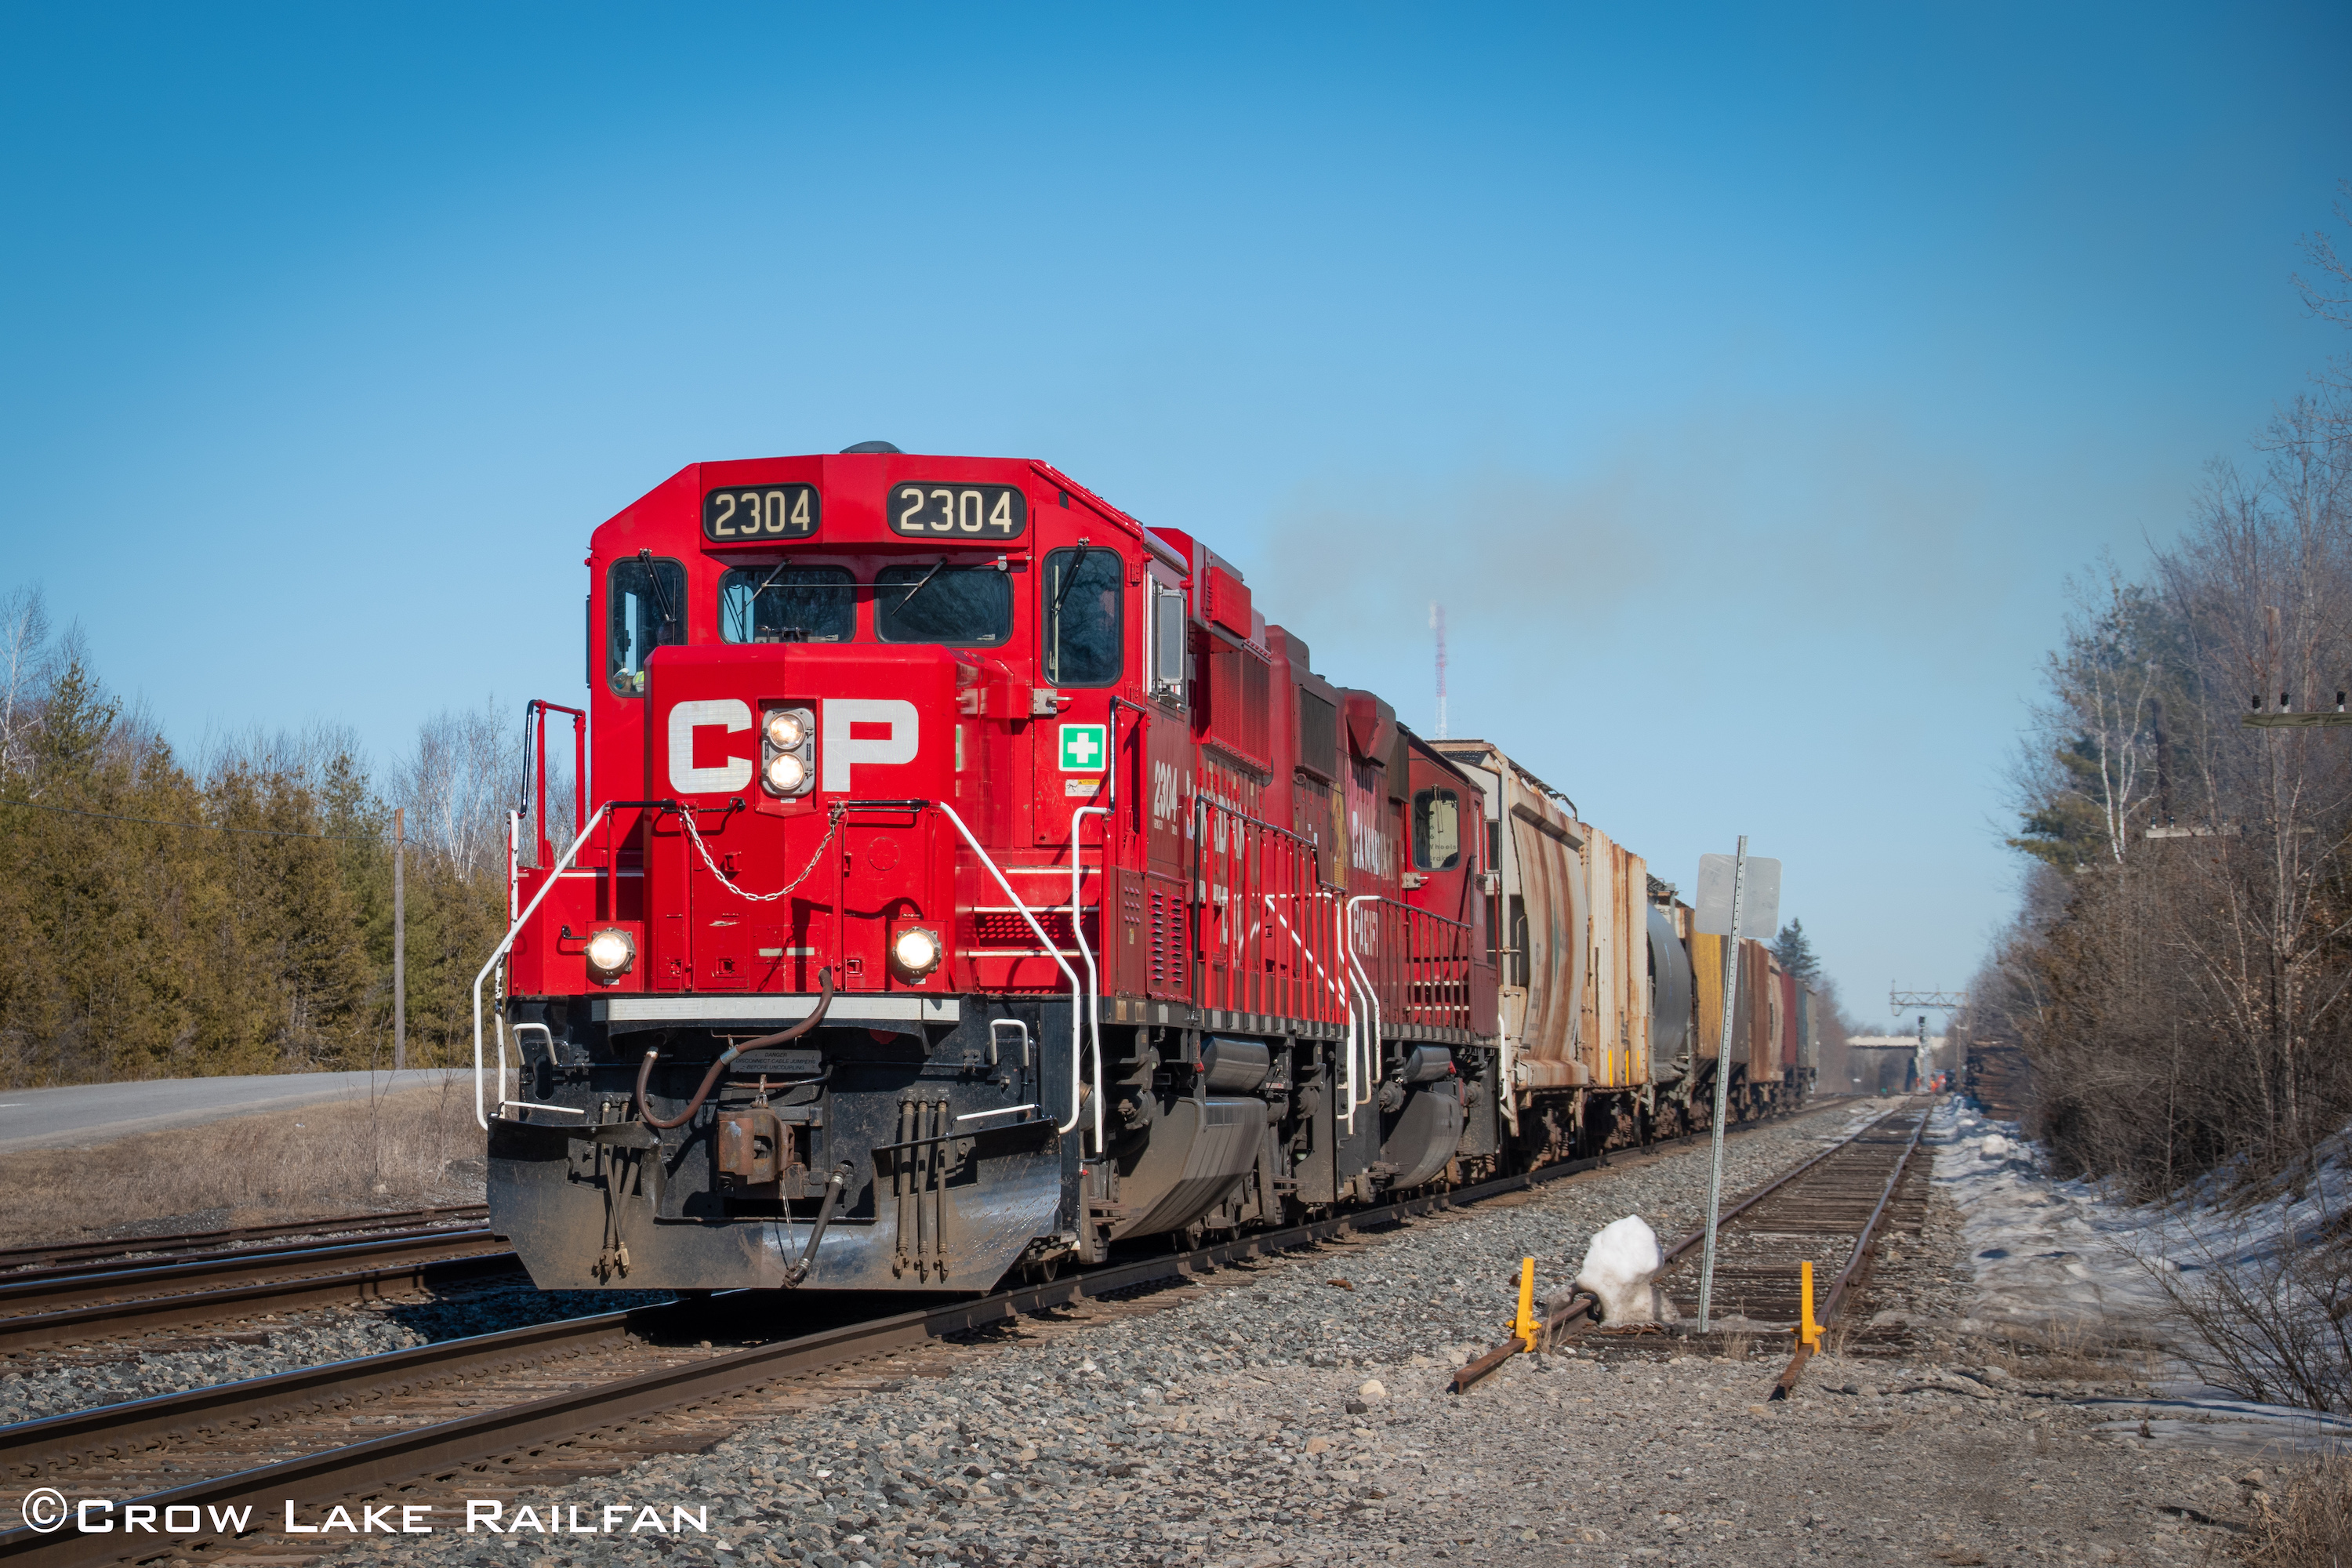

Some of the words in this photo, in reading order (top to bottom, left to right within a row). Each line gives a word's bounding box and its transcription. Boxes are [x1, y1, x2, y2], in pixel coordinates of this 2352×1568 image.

[715, 488, 811, 536] 2304
[900, 488, 1012, 533] 2304
[668, 698, 920, 794] CP
[1153, 759, 1178, 822] 2304
[1352, 811, 1393, 881] CANADIAN
